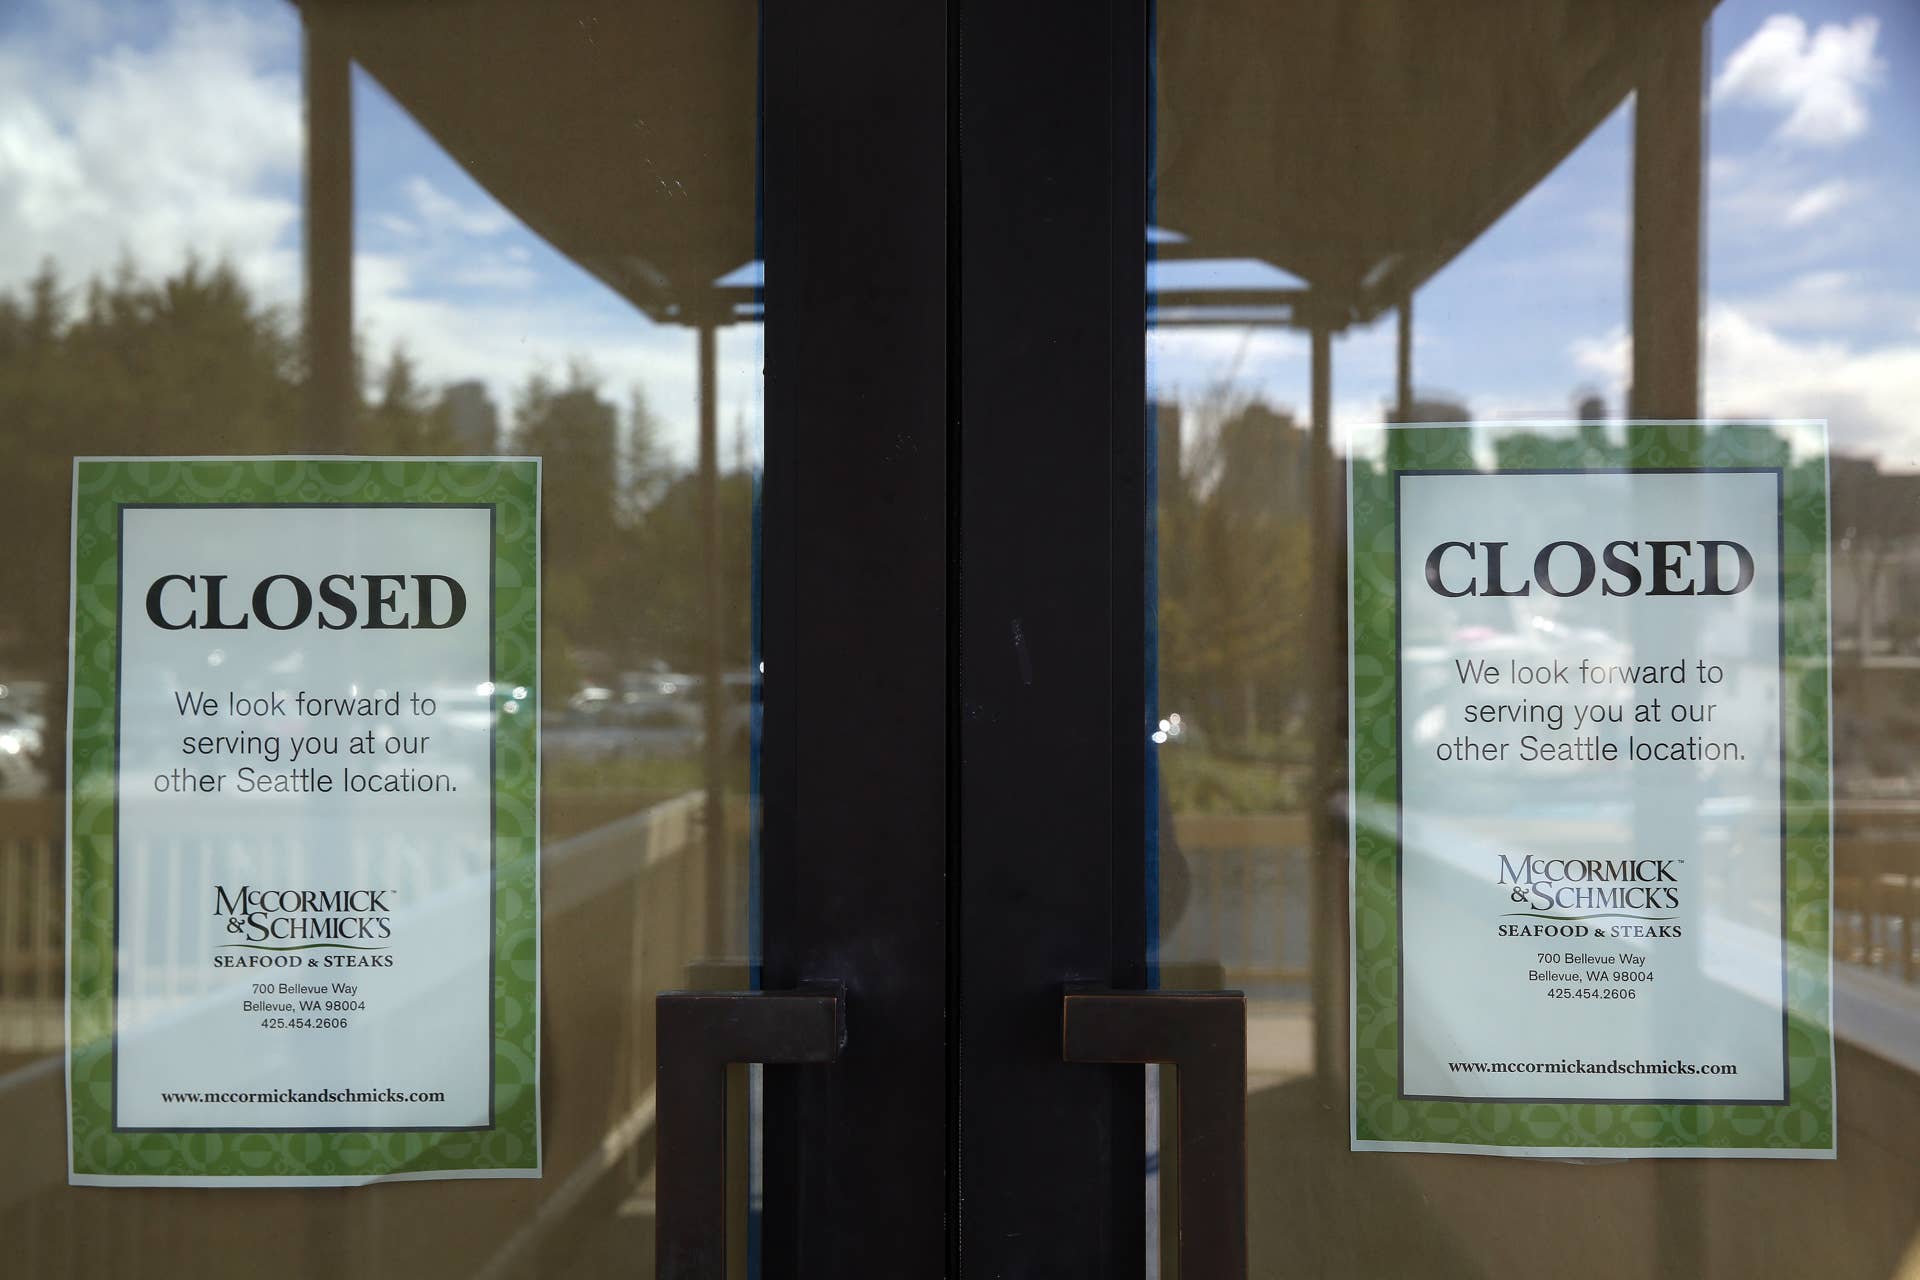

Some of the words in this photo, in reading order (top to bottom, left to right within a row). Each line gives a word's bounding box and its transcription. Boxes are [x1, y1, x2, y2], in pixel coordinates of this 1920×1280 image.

[1425, 541, 1754, 597] CLOSED
[146, 574, 466, 630] CLOSED
[1456, 660, 1499, 684] We
[1512, 659, 1568, 684] look
[1579, 659, 1685, 684] forward
[1696, 660, 1723, 683] to
[175, 692, 218, 716] We
[230, 692, 285, 716] look
[296, 691, 399, 716] forward
[410, 692, 436, 716] to
[1465, 699, 1562, 730] serving
[1574, 705, 1622, 730] you
[1635, 698, 1661, 722] at
[1671, 705, 1716, 722] our
[183, 731, 279, 762] serving
[290, 737, 337, 761] you
[350, 730, 375, 754] at
[385, 737, 430, 754] our
[1437, 736, 1509, 760] other
[1520, 736, 1617, 761] Seattle
[1630, 736, 1744, 760] location.
[155, 768, 226, 792] other
[237, 767, 332, 792] Seattle
[345, 768, 456, 792] location.
[1499, 925, 1588, 937] SEAFOOD
[1611, 926, 1681, 937] STEAKS
[214, 956, 302, 967] SEAFOOD
[324, 955, 393, 967] STEAKS
[1538, 953, 1560, 963] 700
[1565, 953, 1615, 964] Bellevue
[1619, 954, 1645, 967] Way
[1529, 970, 1582, 983] Bellevue,
[1586, 971, 1609, 981] WA
[1613, 971, 1653, 981] 98004
[253, 984, 274, 994] 700
[279, 984, 328, 994] Bellevue
[331, 983, 357, 996] Way
[1548, 989, 1635, 999] 425.454.2606
[244, 1001, 295, 1012] Bellevue,
[299, 1001, 321, 1011] WA
[325, 1001, 365, 1011] 98004
[262, 1018, 347, 1028] 425.454.2606
[1449, 1060, 1737, 1074] www.mccormickandschmicks.com
[162, 1088, 444, 1102] www.mccormickandschmicks.com
